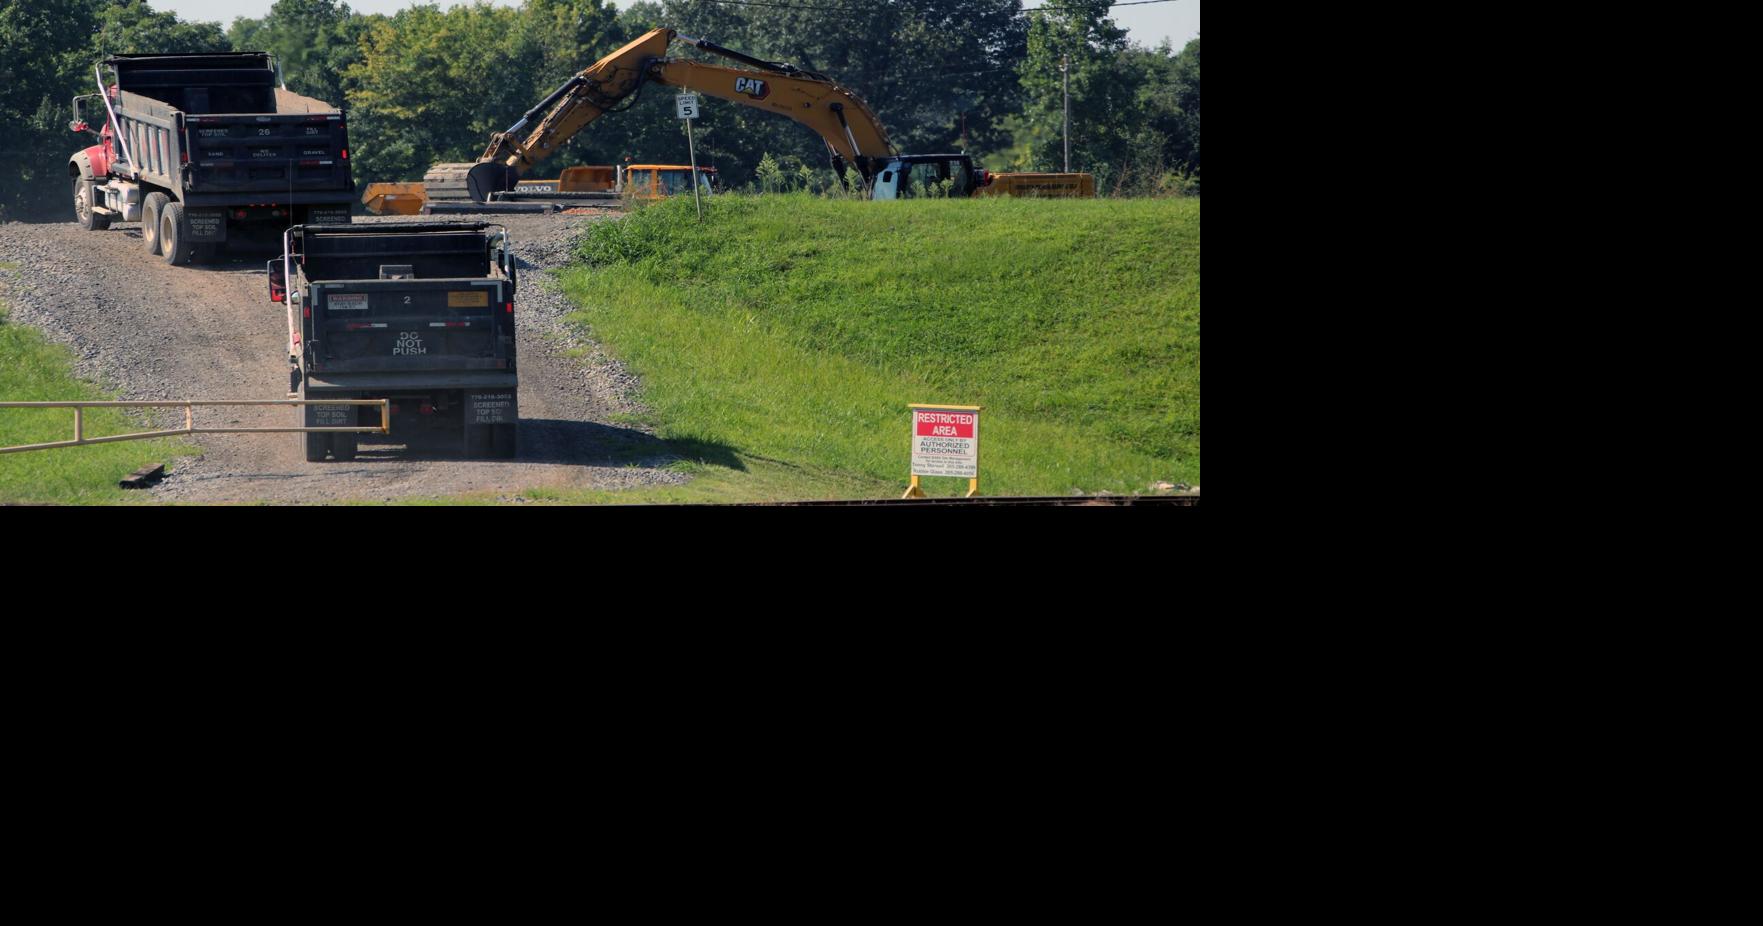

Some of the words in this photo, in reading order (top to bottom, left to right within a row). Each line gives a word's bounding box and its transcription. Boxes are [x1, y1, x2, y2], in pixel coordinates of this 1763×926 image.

[735, 77, 764, 96] CAT
[683, 106, 692, 116] 5
[404, 296, 411, 304] 2
[396, 340, 422, 348] NOT
[918, 412, 973, 424] RESTRICTED
[932, 426, 958, 436] AREA
